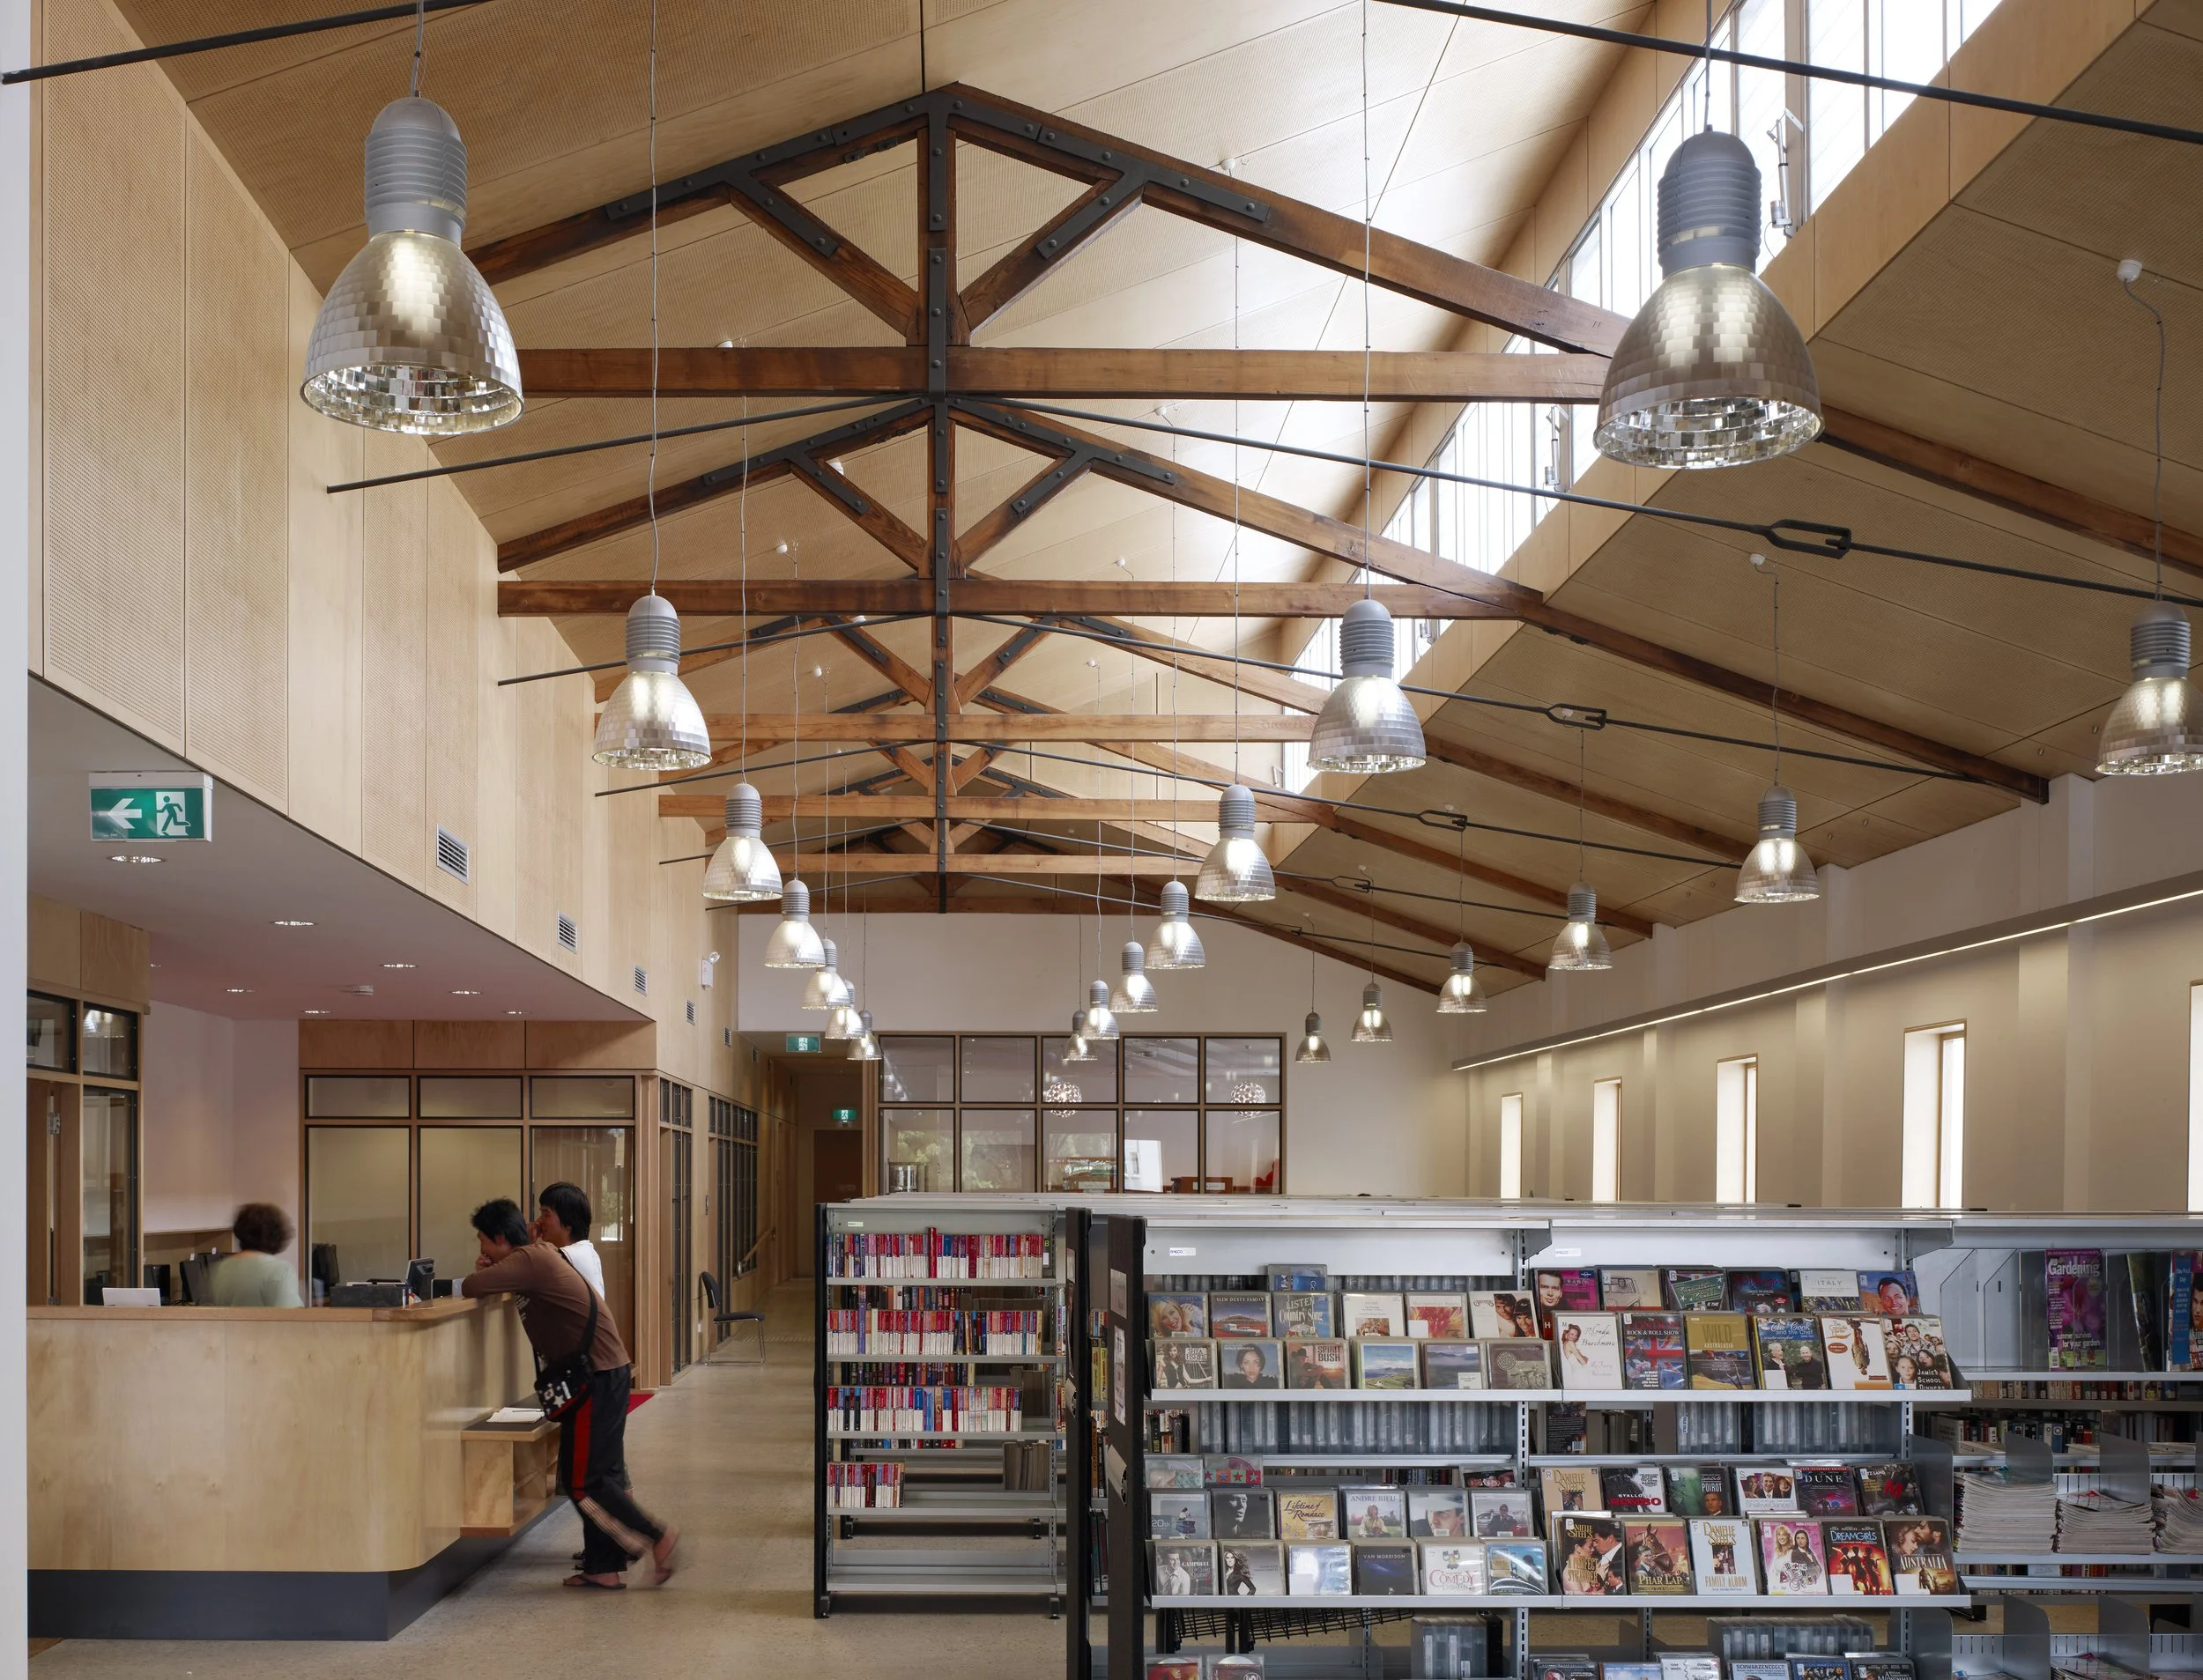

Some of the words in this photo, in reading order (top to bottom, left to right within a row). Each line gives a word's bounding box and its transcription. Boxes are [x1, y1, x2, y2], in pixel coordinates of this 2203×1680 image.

[2047, 1257, 2101, 1277] Gardening
[1287, 1297, 1315, 1310] LISTEN
[1279, 1308, 1306, 1324] Country
[1789, 1321, 1812, 1331] Cook
[1702, 1324, 1732, 1343] WILD
[1317, 1345, 1341, 1354] SPIRIT
[2082, 1339, 2101, 1348] garden
[1317, 1353, 1341, 1362] BUSH
[1554, 1469, 1585, 1482] DANIELLE
[1701, 1483, 1723, 1492] POIROT
[1883, 1479, 1903, 1499] M
[1283, 1500, 1316, 1514] Lifetime
[1609, 1497, 1662, 1506] RAMBO
[1293, 1509, 1326, 1522] Romance
[1152, 1519, 1170, 1528] 20th
[1703, 1521, 1735, 1536] DANIELLE
[1829, 1530, 1878, 1542] DREAMGIRLS
[1572, 1558, 1599, 1570] PERFECT
[1899, 1555, 1948, 1572] AUSTRALIA
[1428, 1569, 1478, 1587] COMEDY
[1567, 1570, 1598, 1583] STRANGER
[1638, 1573, 1662, 1586] PHAR
[1665, 1573, 1682, 1586] LAP
[1704, 1575, 1727, 1587] FAMILY
[1727, 1575, 1748, 1587] ALBUM
